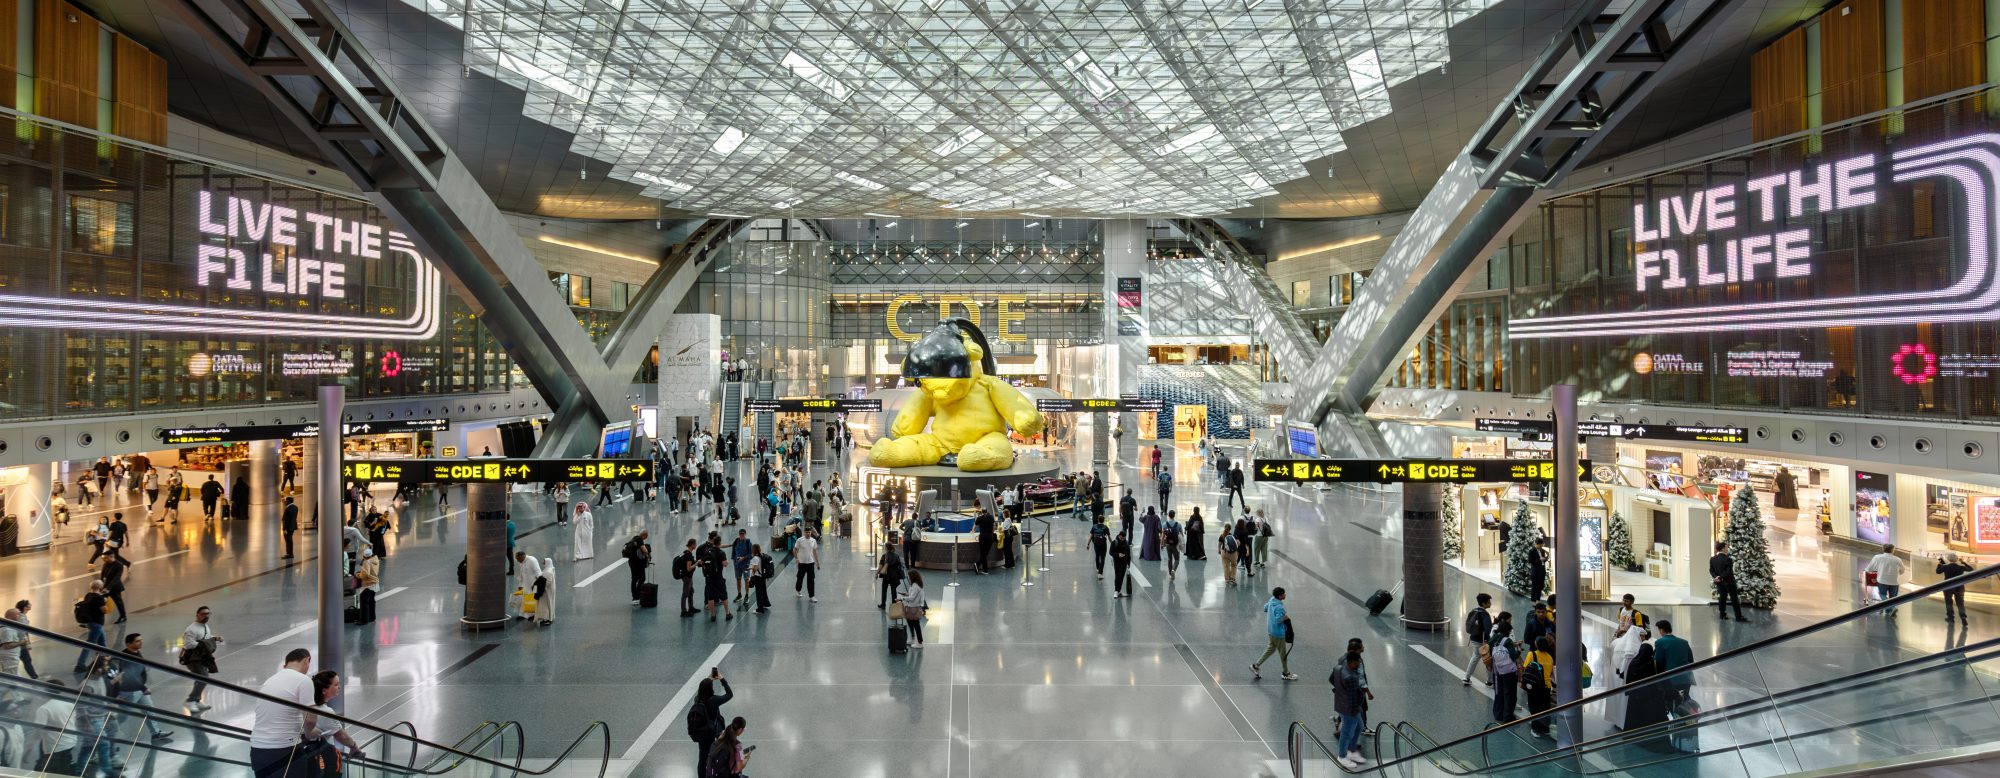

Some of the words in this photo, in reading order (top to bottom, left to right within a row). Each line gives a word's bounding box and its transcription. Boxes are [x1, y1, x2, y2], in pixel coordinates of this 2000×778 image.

[1634, 184, 1736, 242] LIVE
[1747, 153, 1877, 222] THE
[200, 190, 297, 246] LIVE
[306, 211, 382, 259] THE
[1636, 249, 1686, 291] F1
[1697, 229, 1811, 286] LIFE
[198, 245, 251, 290] F1
[262, 253, 345, 298] LIFE
[212, 354, 244, 363] QATAR
[1653, 353, 1683, 362] QATAR
[212, 362, 240, 371] DUTY
[241, 363, 262, 372] FREE
[1653, 362, 1680, 371] DUTY
[1680, 362, 1704, 371] FREE
[1539, 433, 1553, 441] DI
[373, 466, 384, 478] A
[451, 466, 482, 478] CDE
[586, 465, 596, 477] B
[1312, 465, 1324, 477] A
[1428, 465, 1459, 478] CDE
[1528, 465, 1538, 477] B
